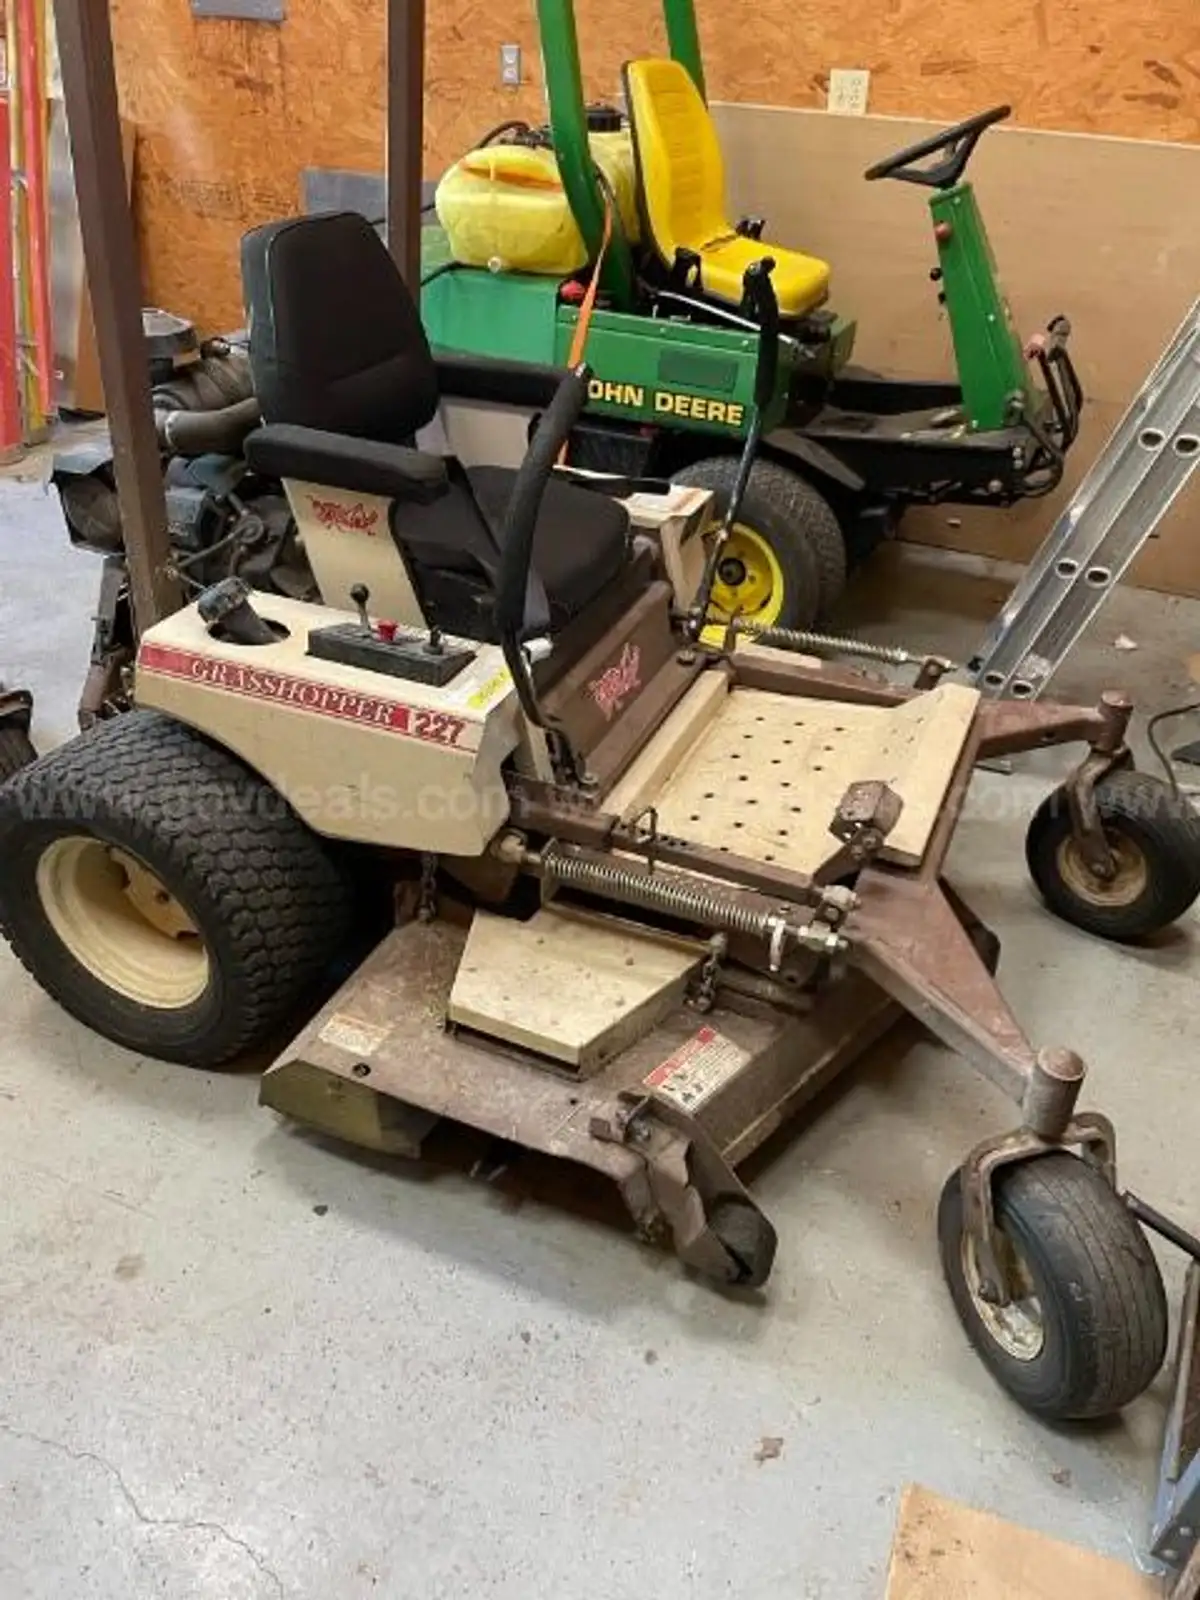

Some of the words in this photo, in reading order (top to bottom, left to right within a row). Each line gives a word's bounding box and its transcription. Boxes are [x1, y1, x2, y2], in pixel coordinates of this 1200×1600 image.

[587, 379, 644, 406] OHN
[654, 391, 743, 426] DEERE
[192, 659, 394, 724] GRASSHOPPER
[414, 714, 467, 745] 227
